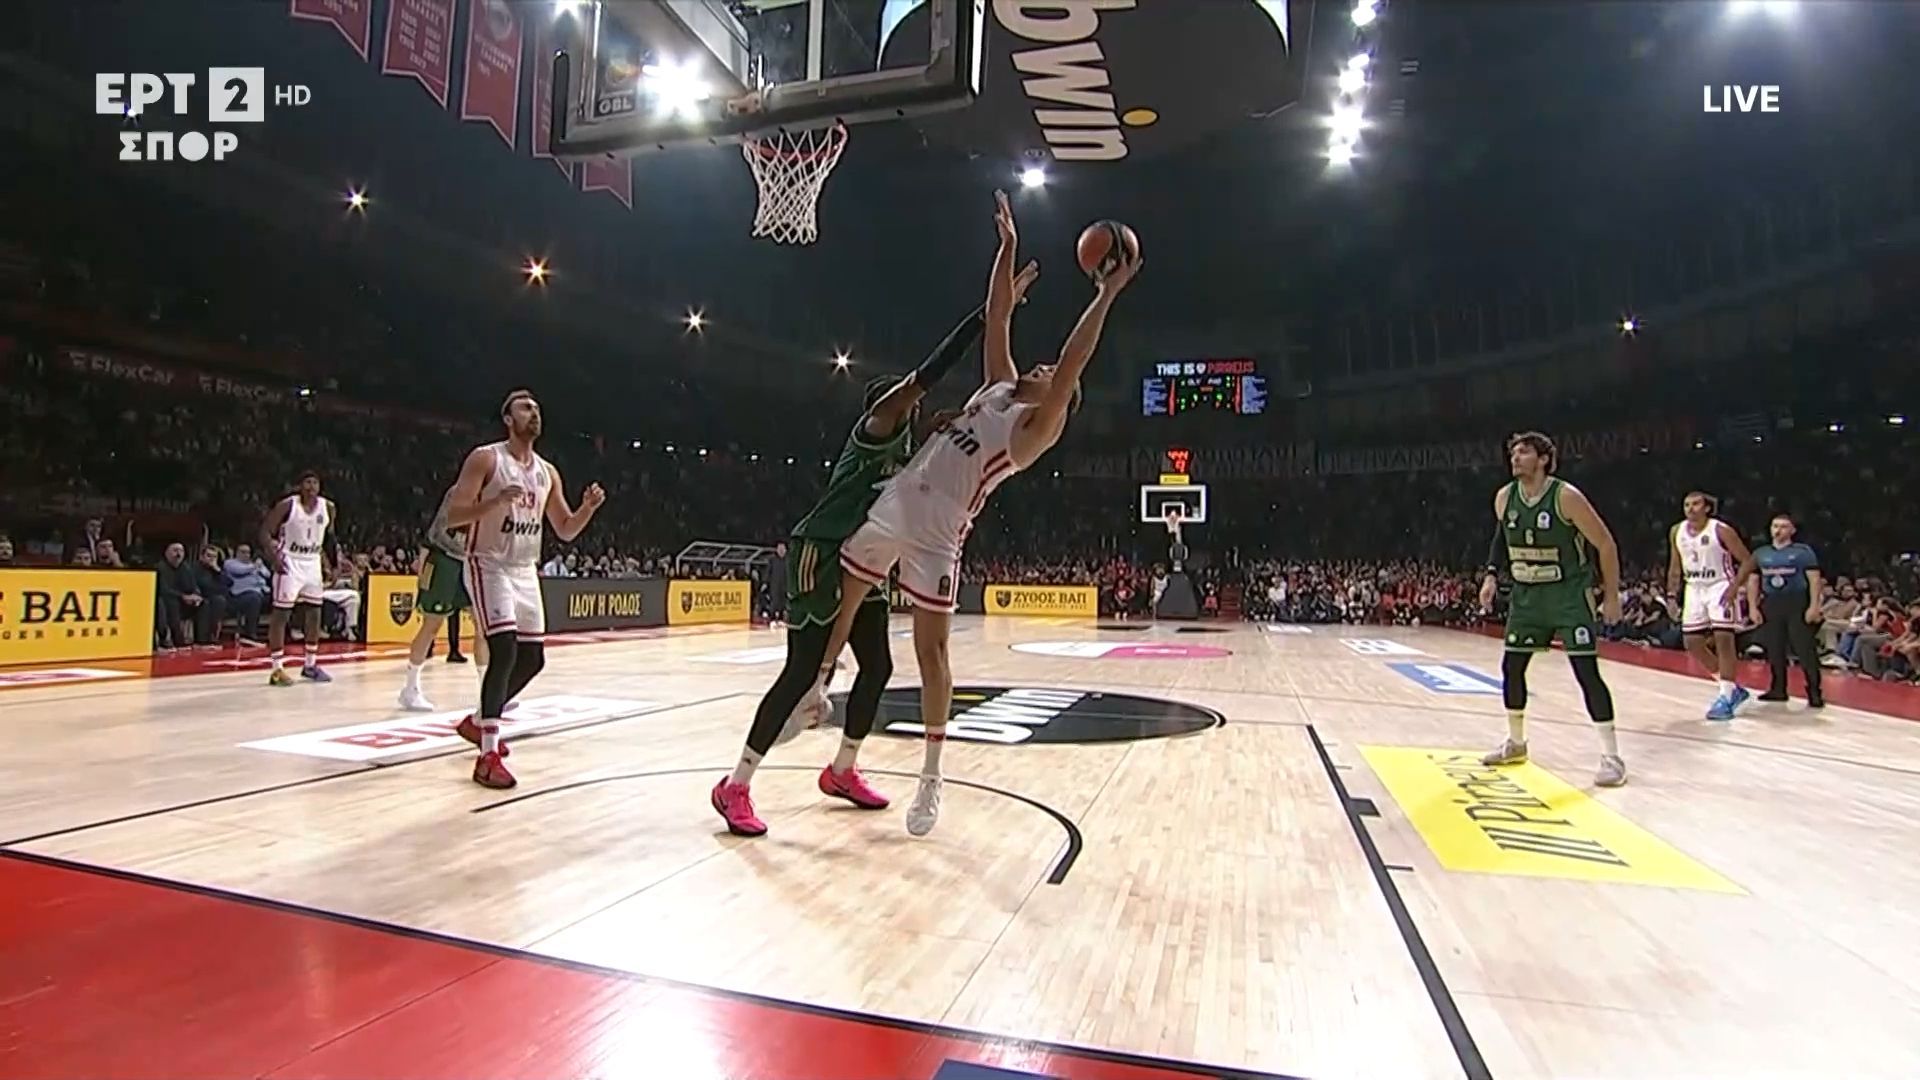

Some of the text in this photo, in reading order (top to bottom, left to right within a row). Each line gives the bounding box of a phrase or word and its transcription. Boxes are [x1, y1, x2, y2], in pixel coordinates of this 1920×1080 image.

[990, 0, 1158, 161] bwin
[598, 97, 632, 114] GBL
[91, 355, 174, 385] FlexCar
[1156, 363, 1180, 375] THIS
[1184, 363, 1195, 375] IS
[20, 591, 120, 623] ΒΑΠ
[569, 594, 595, 618] ΙΔΟΥ
[608, 592, 641, 616] ΡΟΔΟΣ
[1014, 592, 1056, 604] ΖΥΘΟΣ
[66, 627, 118, 637] BEER
[1427, 753, 1574, 828] Piraeus
